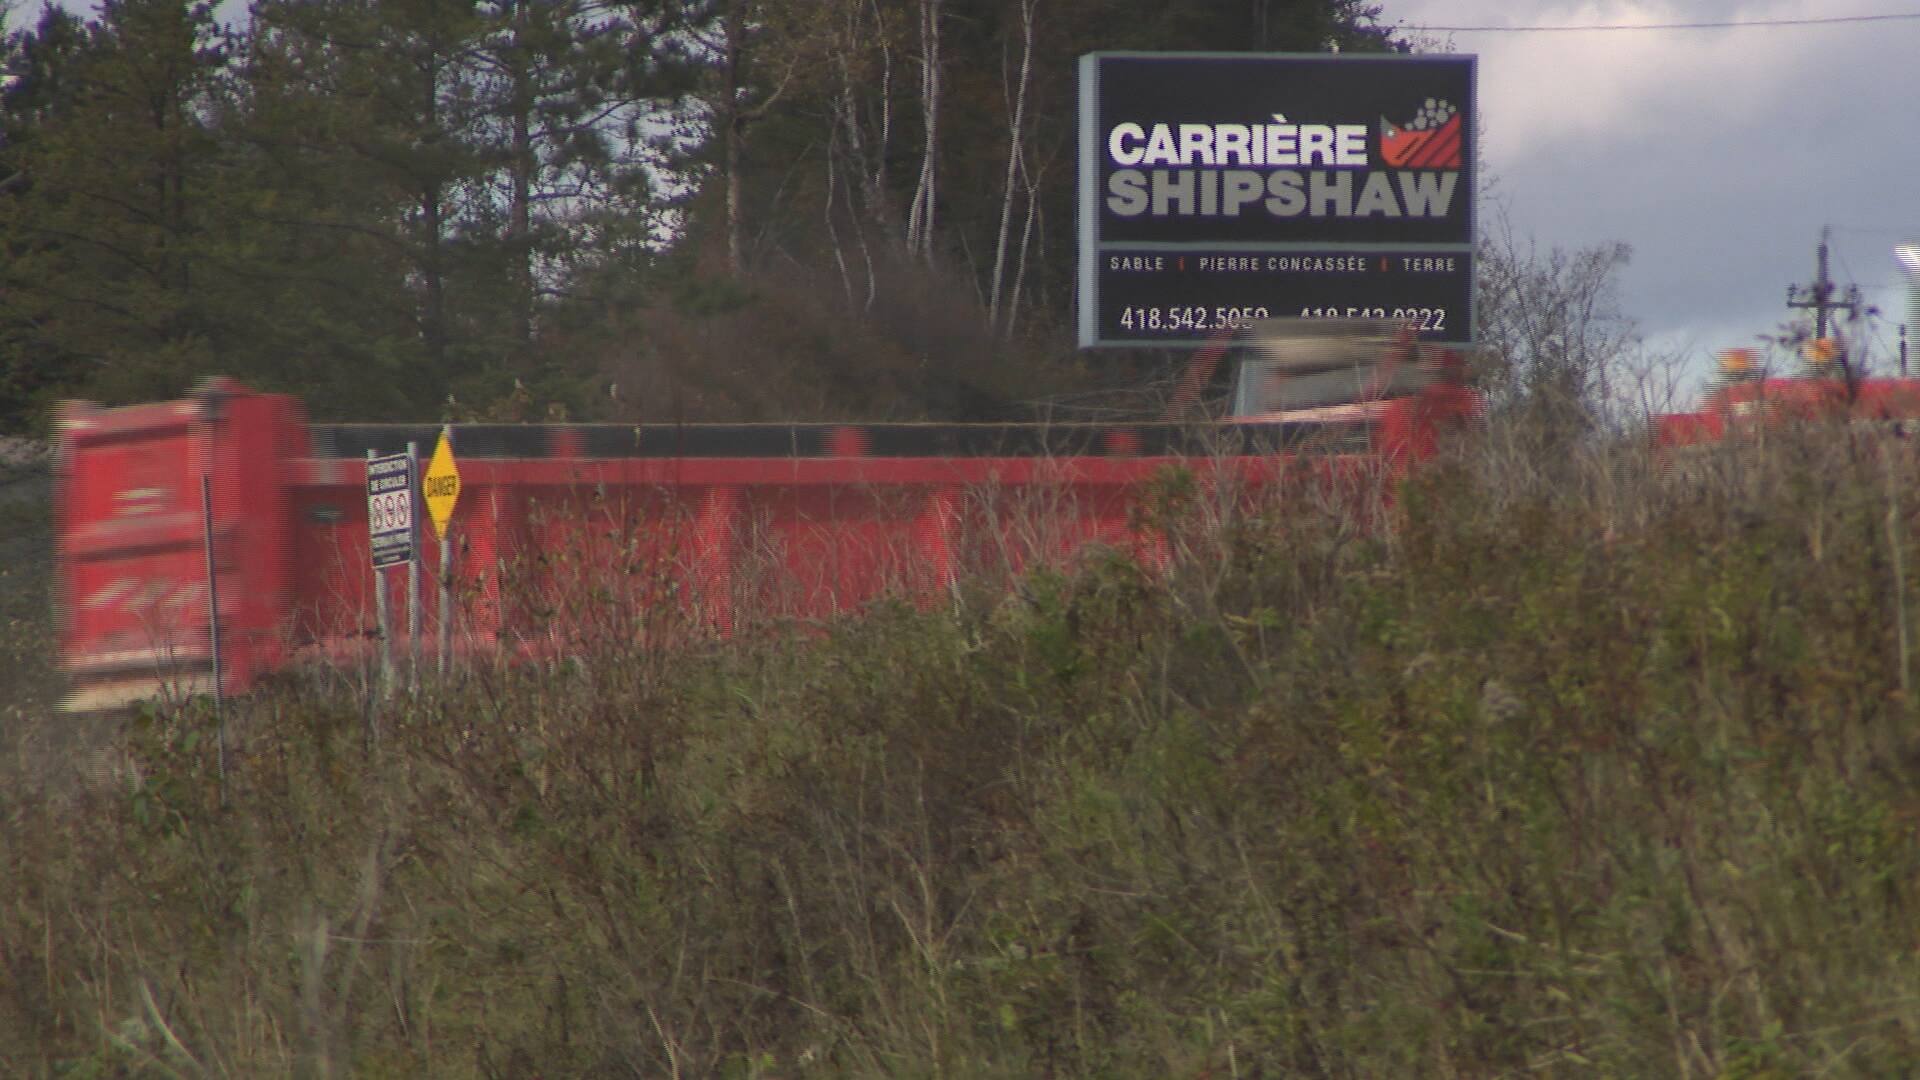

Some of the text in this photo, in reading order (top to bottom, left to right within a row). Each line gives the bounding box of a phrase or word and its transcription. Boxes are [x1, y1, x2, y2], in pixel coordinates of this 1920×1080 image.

[1108, 113, 1368, 166] CARRIÈRE
[1107, 169, 1460, 217] SHIPSHAW
[1110, 254, 1456, 272] SABLE PIERRE CONCASSÉE TERRE
[426, 475, 457, 497] DANGER
